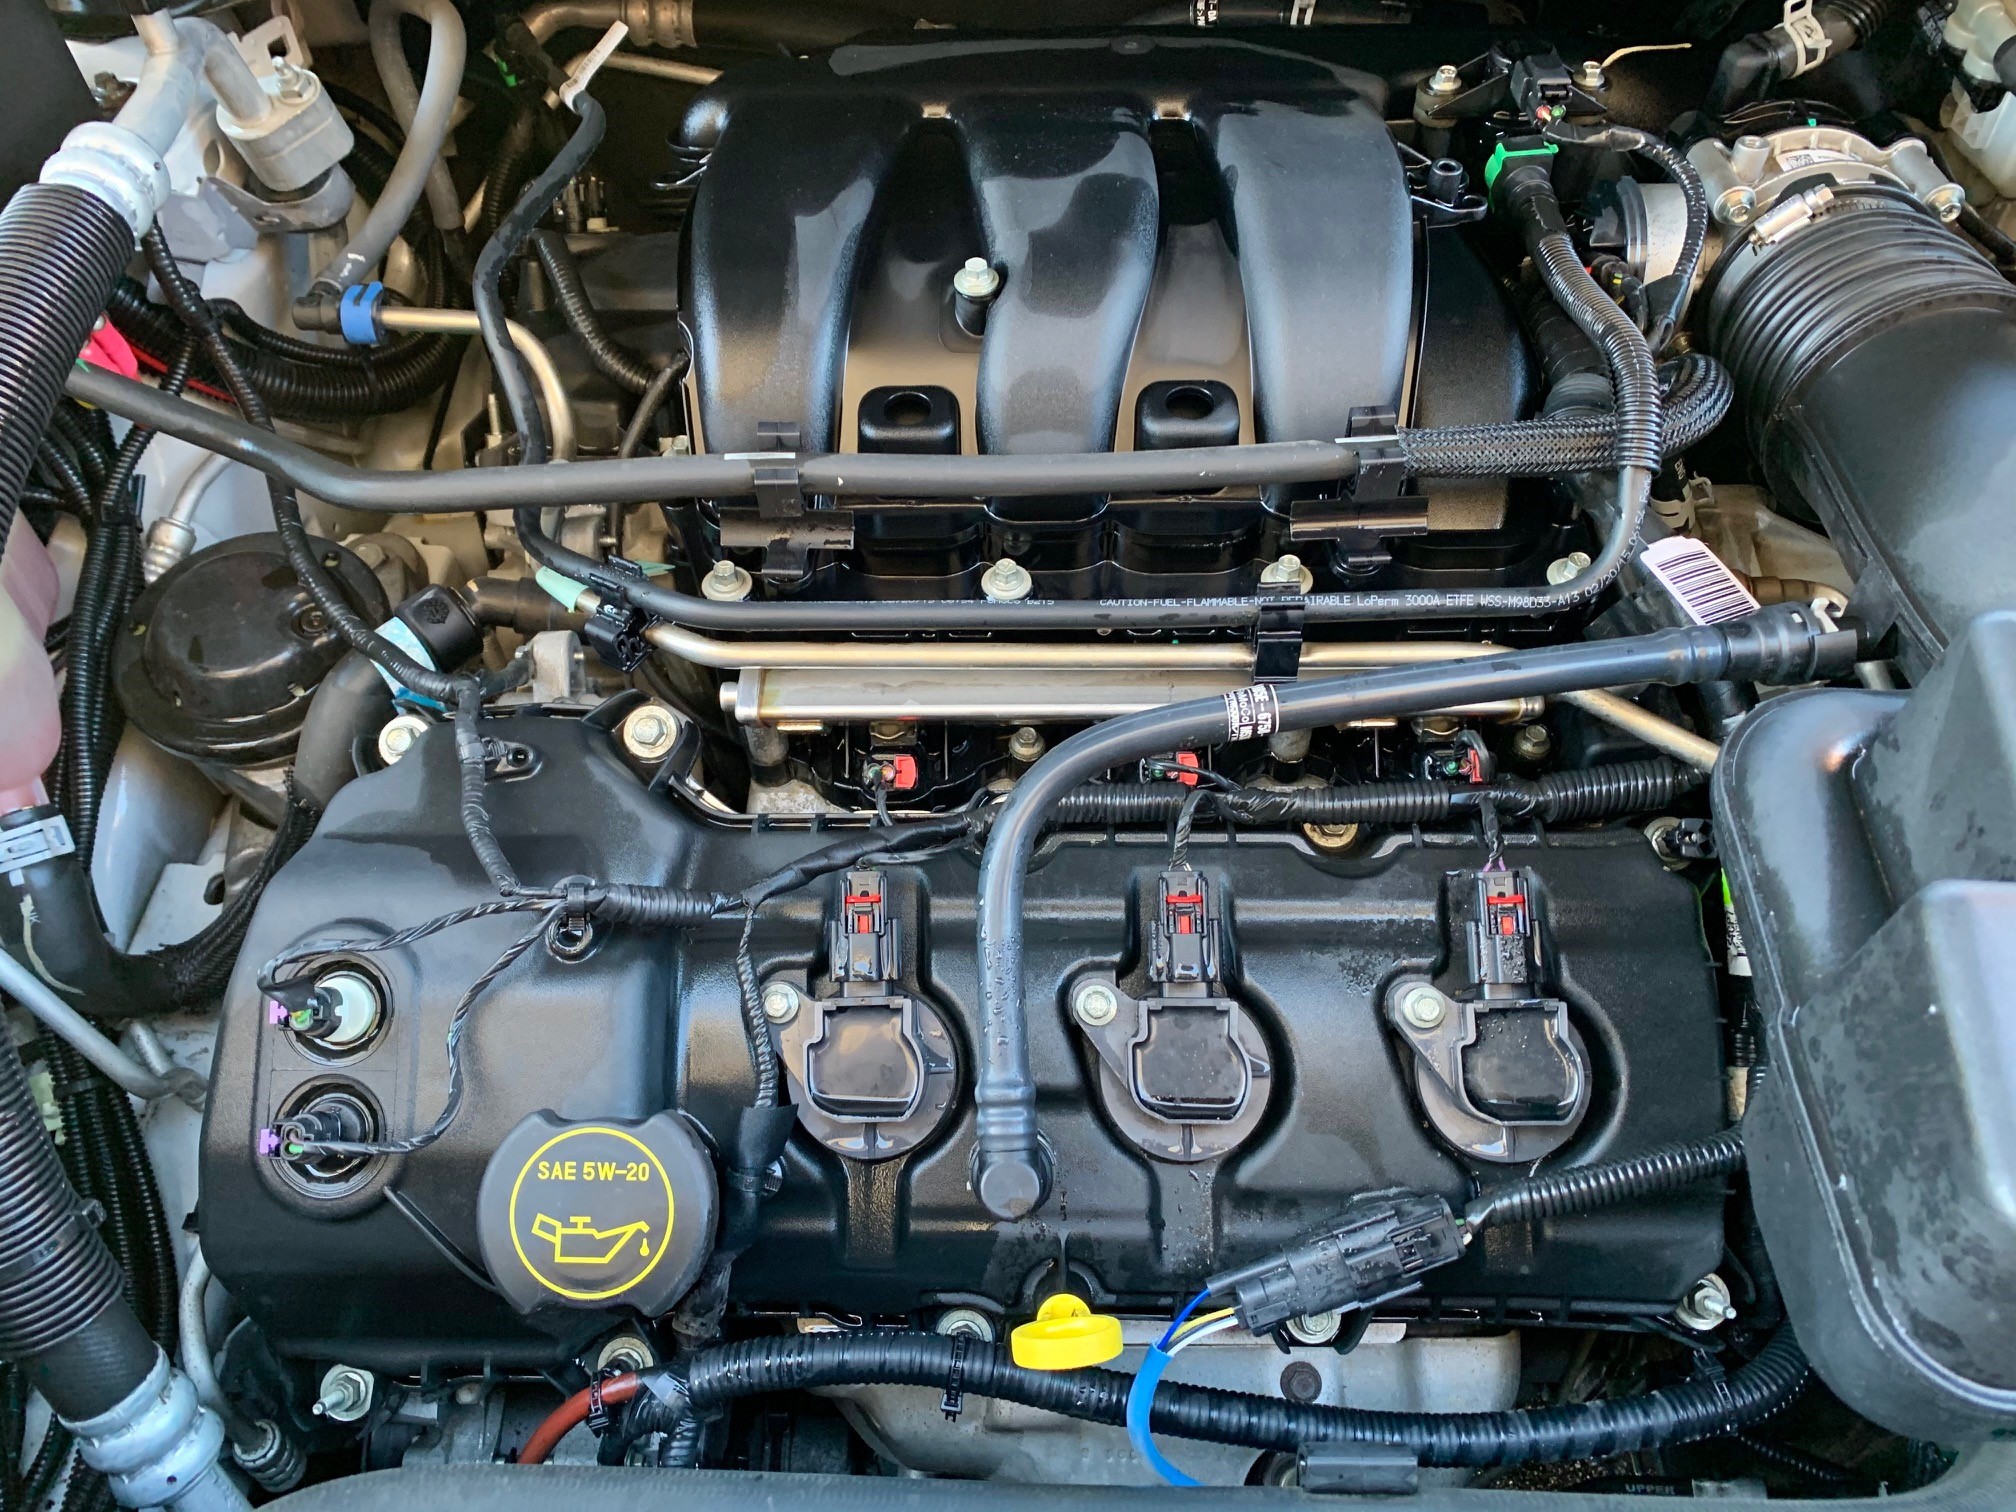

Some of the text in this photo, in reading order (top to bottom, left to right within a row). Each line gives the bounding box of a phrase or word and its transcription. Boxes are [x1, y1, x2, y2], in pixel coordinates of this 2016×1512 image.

[1357, 594, 1399, 606] LoPerm
[1405, 594, 1440, 606] 3000A
[1446, 594, 1474, 606] ETFE
[537, 1161, 650, 1182] SAE 5W-20
